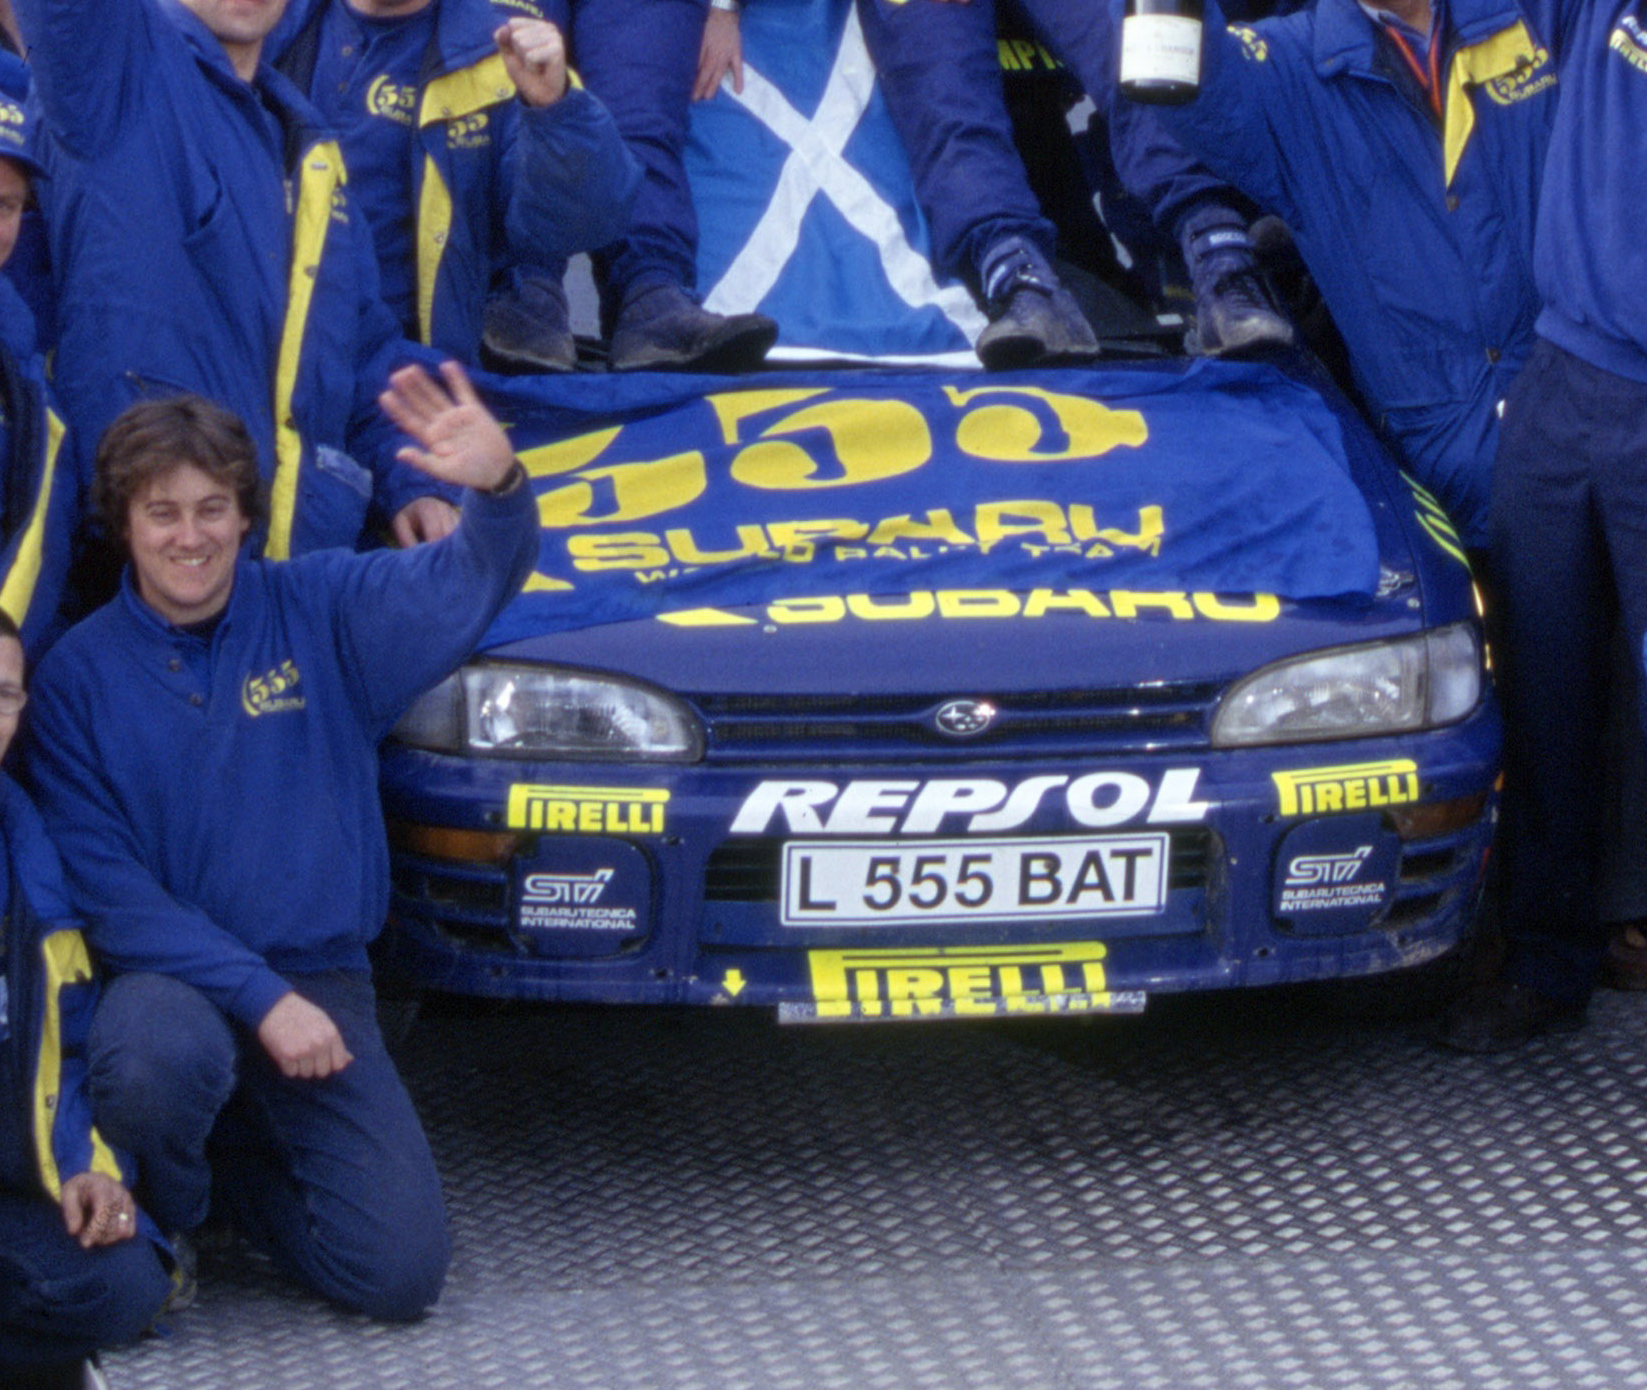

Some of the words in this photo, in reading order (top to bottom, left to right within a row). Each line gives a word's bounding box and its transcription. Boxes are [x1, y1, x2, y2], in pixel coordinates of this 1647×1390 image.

[525, 386, 1150, 528] 555
[567, 499, 1164, 572] SUBARU
[767, 588, 1281, 624] SUBARU
[249, 659, 300, 704] 555
[508, 783, 671, 833] PIRELLI
[729, 767, 1203, 833] REPSOL
[1271, 759, 1420, 816] PIRELLI
[798, 856, 837, 911] L
[862, 853, 995, 911] 555
[1017, 846, 1154, 906] BAT
[1279, 893, 1383, 911] INTERNATIONAL
[1282, 887, 1336, 901] SUBARU
[520, 916, 636, 930] INTERNATIONAL
[521, 905, 578, 918] SUBARU
[807, 940, 1109, 1017] PIRELLI
